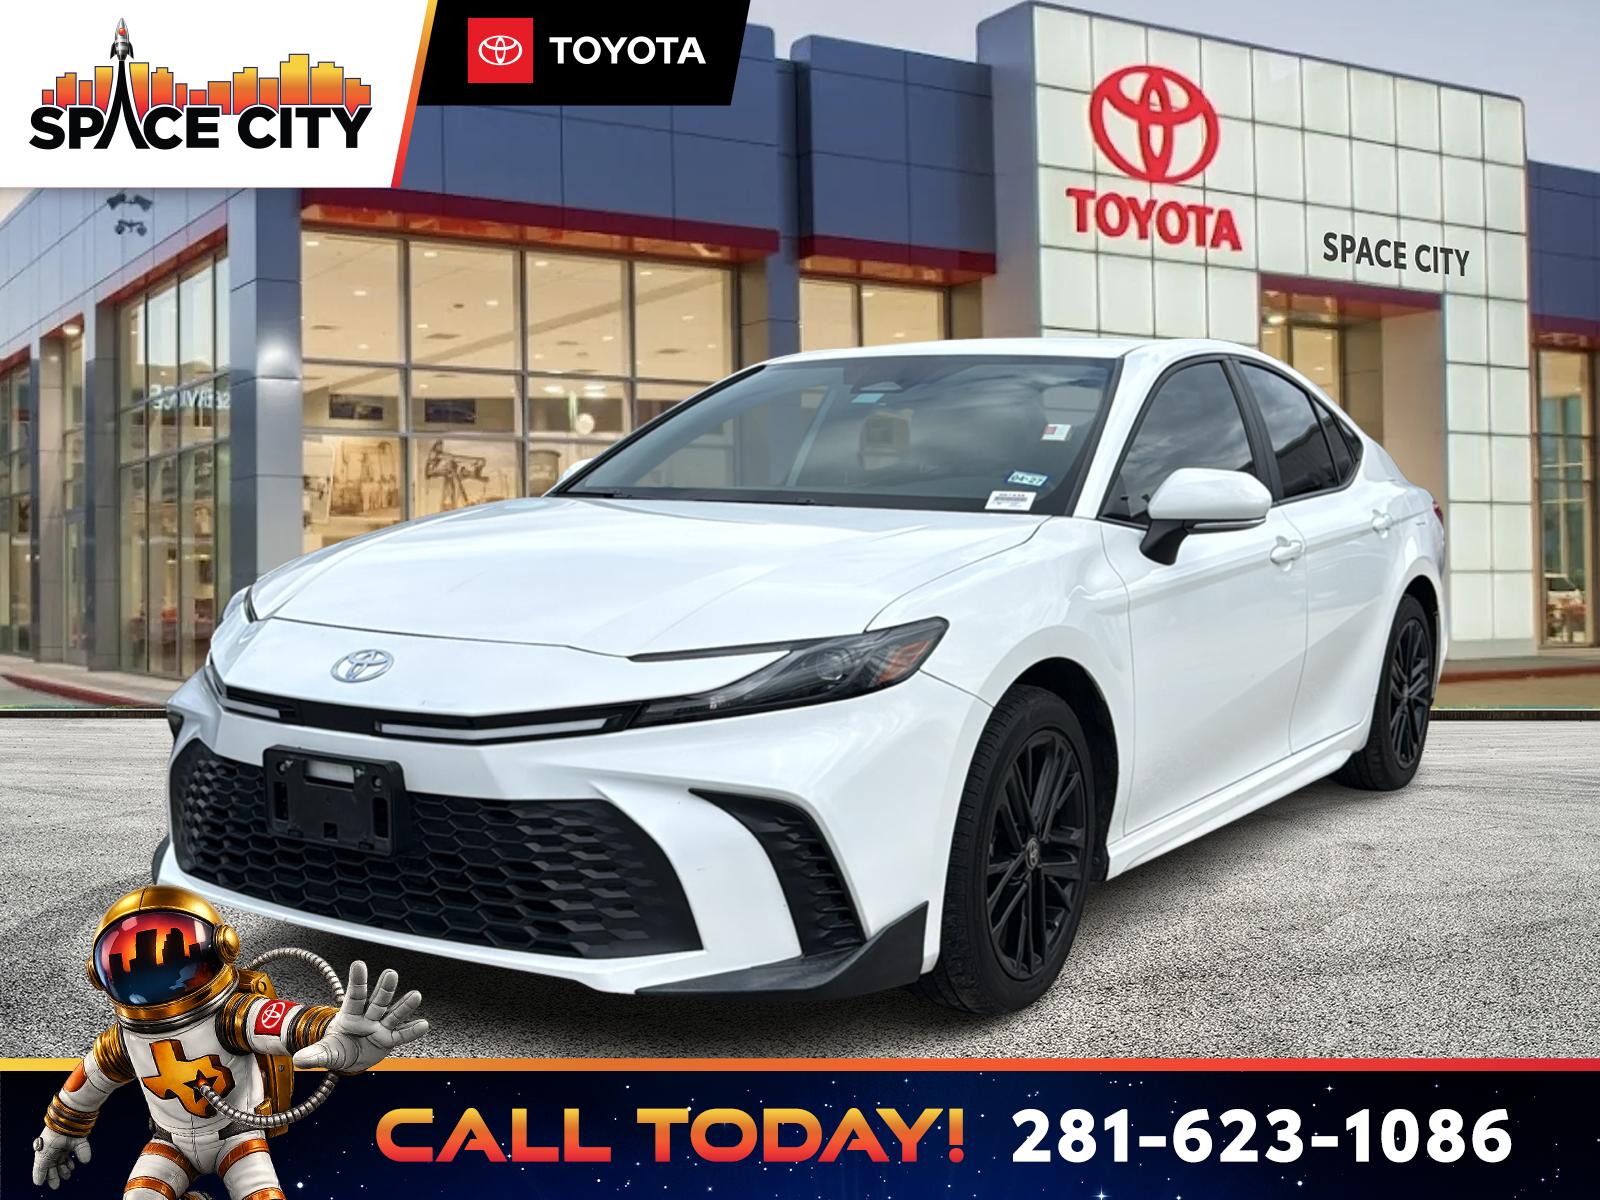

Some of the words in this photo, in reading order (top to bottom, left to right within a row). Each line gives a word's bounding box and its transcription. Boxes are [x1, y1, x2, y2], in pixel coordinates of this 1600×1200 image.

[1065, 187, 1242, 251] TOYOTA
[1323, 231, 1407, 270] SPACE
[1414, 244, 1470, 277] CITY
